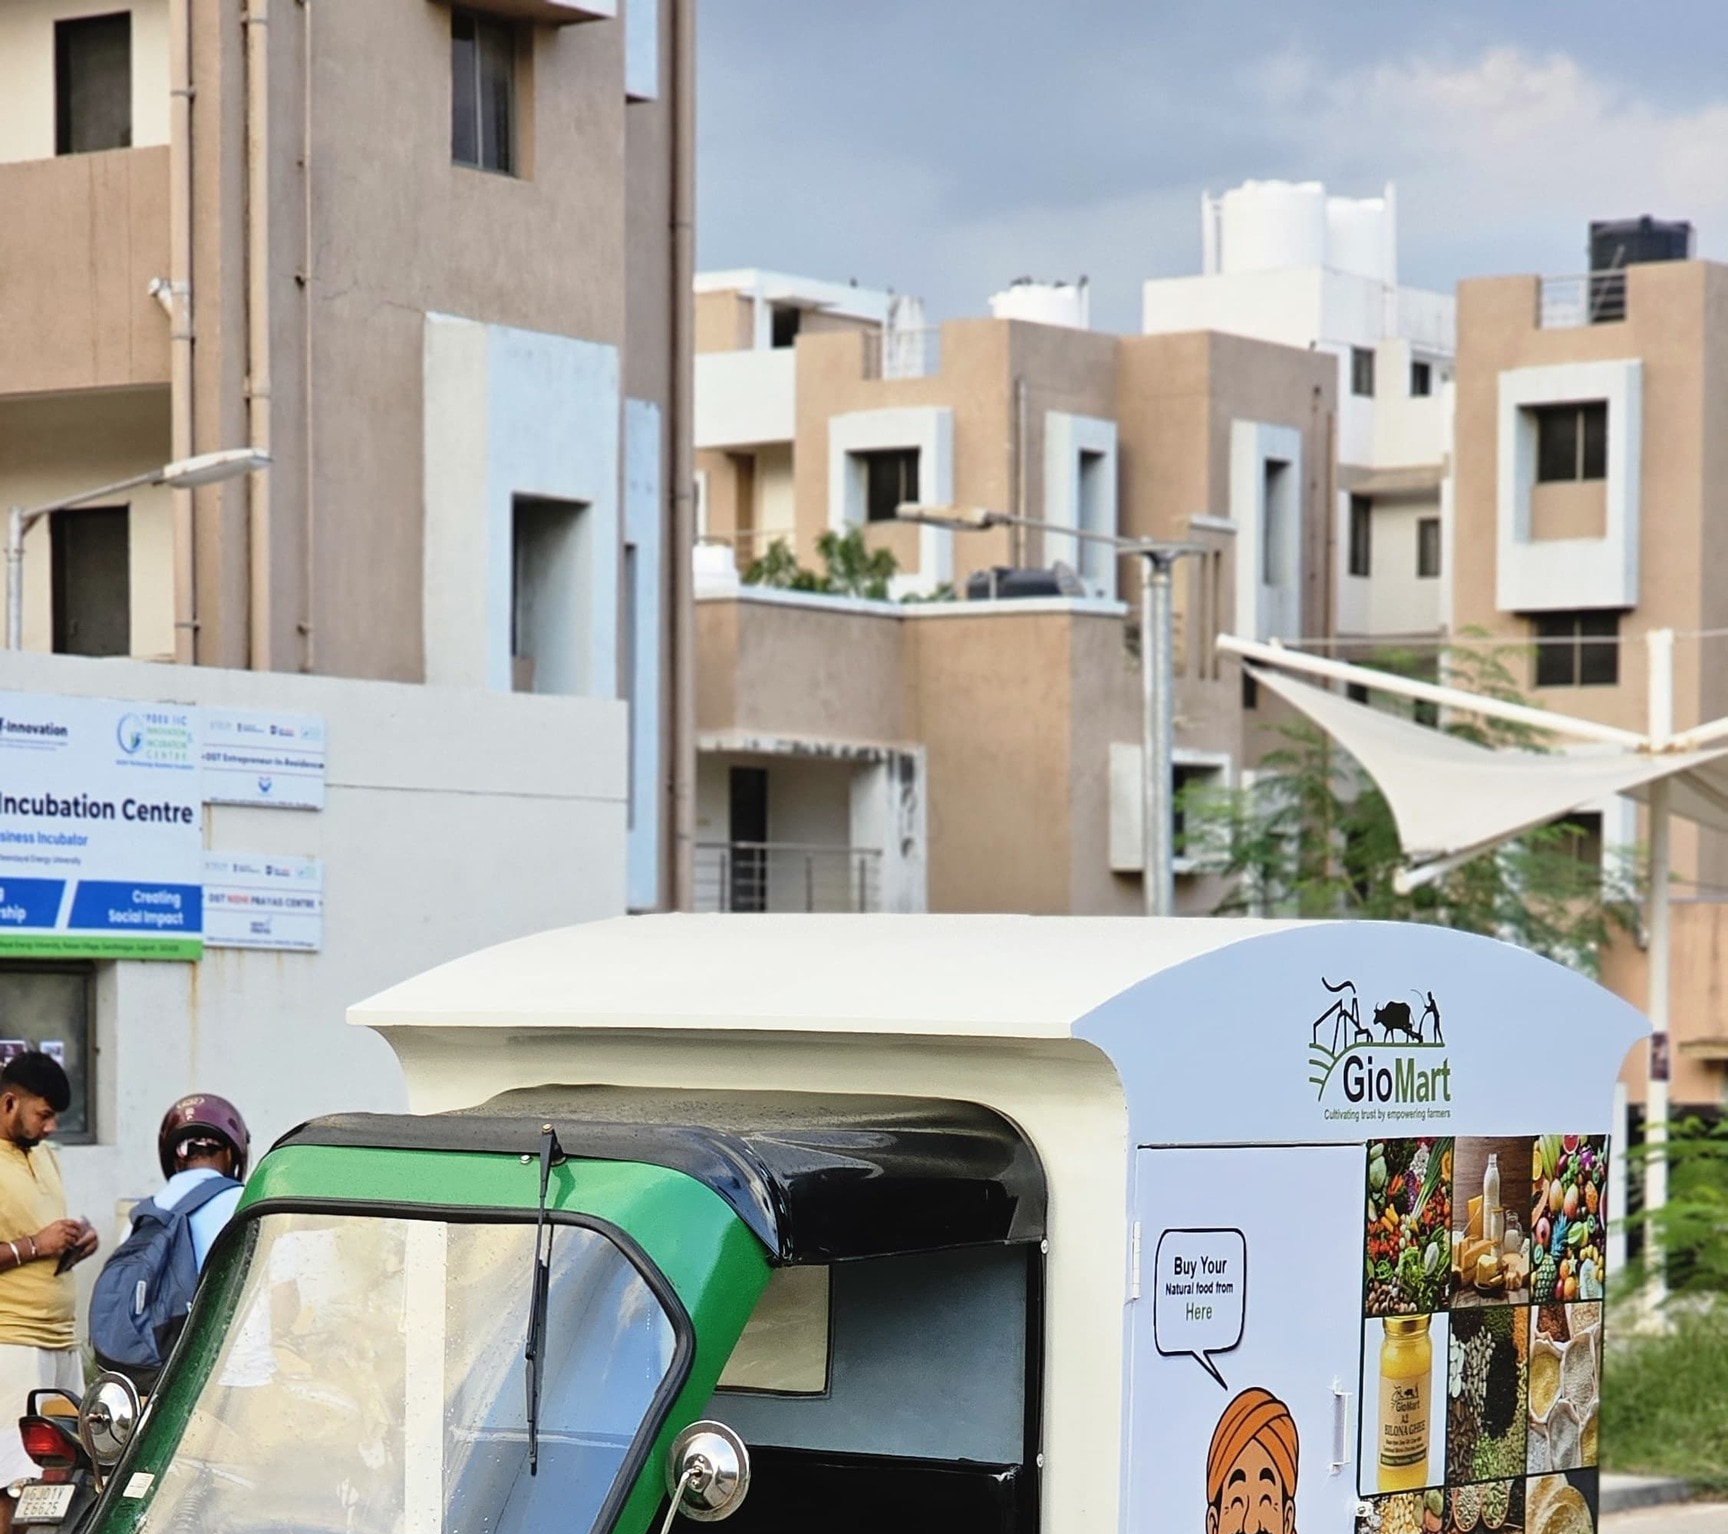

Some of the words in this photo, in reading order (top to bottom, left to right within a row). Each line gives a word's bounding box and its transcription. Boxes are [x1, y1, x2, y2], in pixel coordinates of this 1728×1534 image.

[122, 798, 194, 824] Centre
[37, 831, 88, 847] Incubator
[132, 889, 181, 909] Creating
[0, 904, 27, 924] ship
[108, 908, 142, 924] Social
[143, 909, 184, 928] Impact
[1343, 1055, 1451, 1103] GioMart
[1324, 1108, 1359, 1122] Cultivating
[1361, 1109, 1377, 1119] trust
[1378, 1109, 1385, 1121] by
[1387, 1108, 1426, 1121] empowering
[1427, 1107, 1451, 1119] farmers
[1174, 1256, 1197, 1279] Buy
[1200, 1256, 1227, 1274] Your
[1165, 1282, 1194, 1296] Natural
[1196, 1281, 1214, 1294] food
[1216, 1281, 1234, 1294] from
[1186, 1302, 1212, 1320] Here
